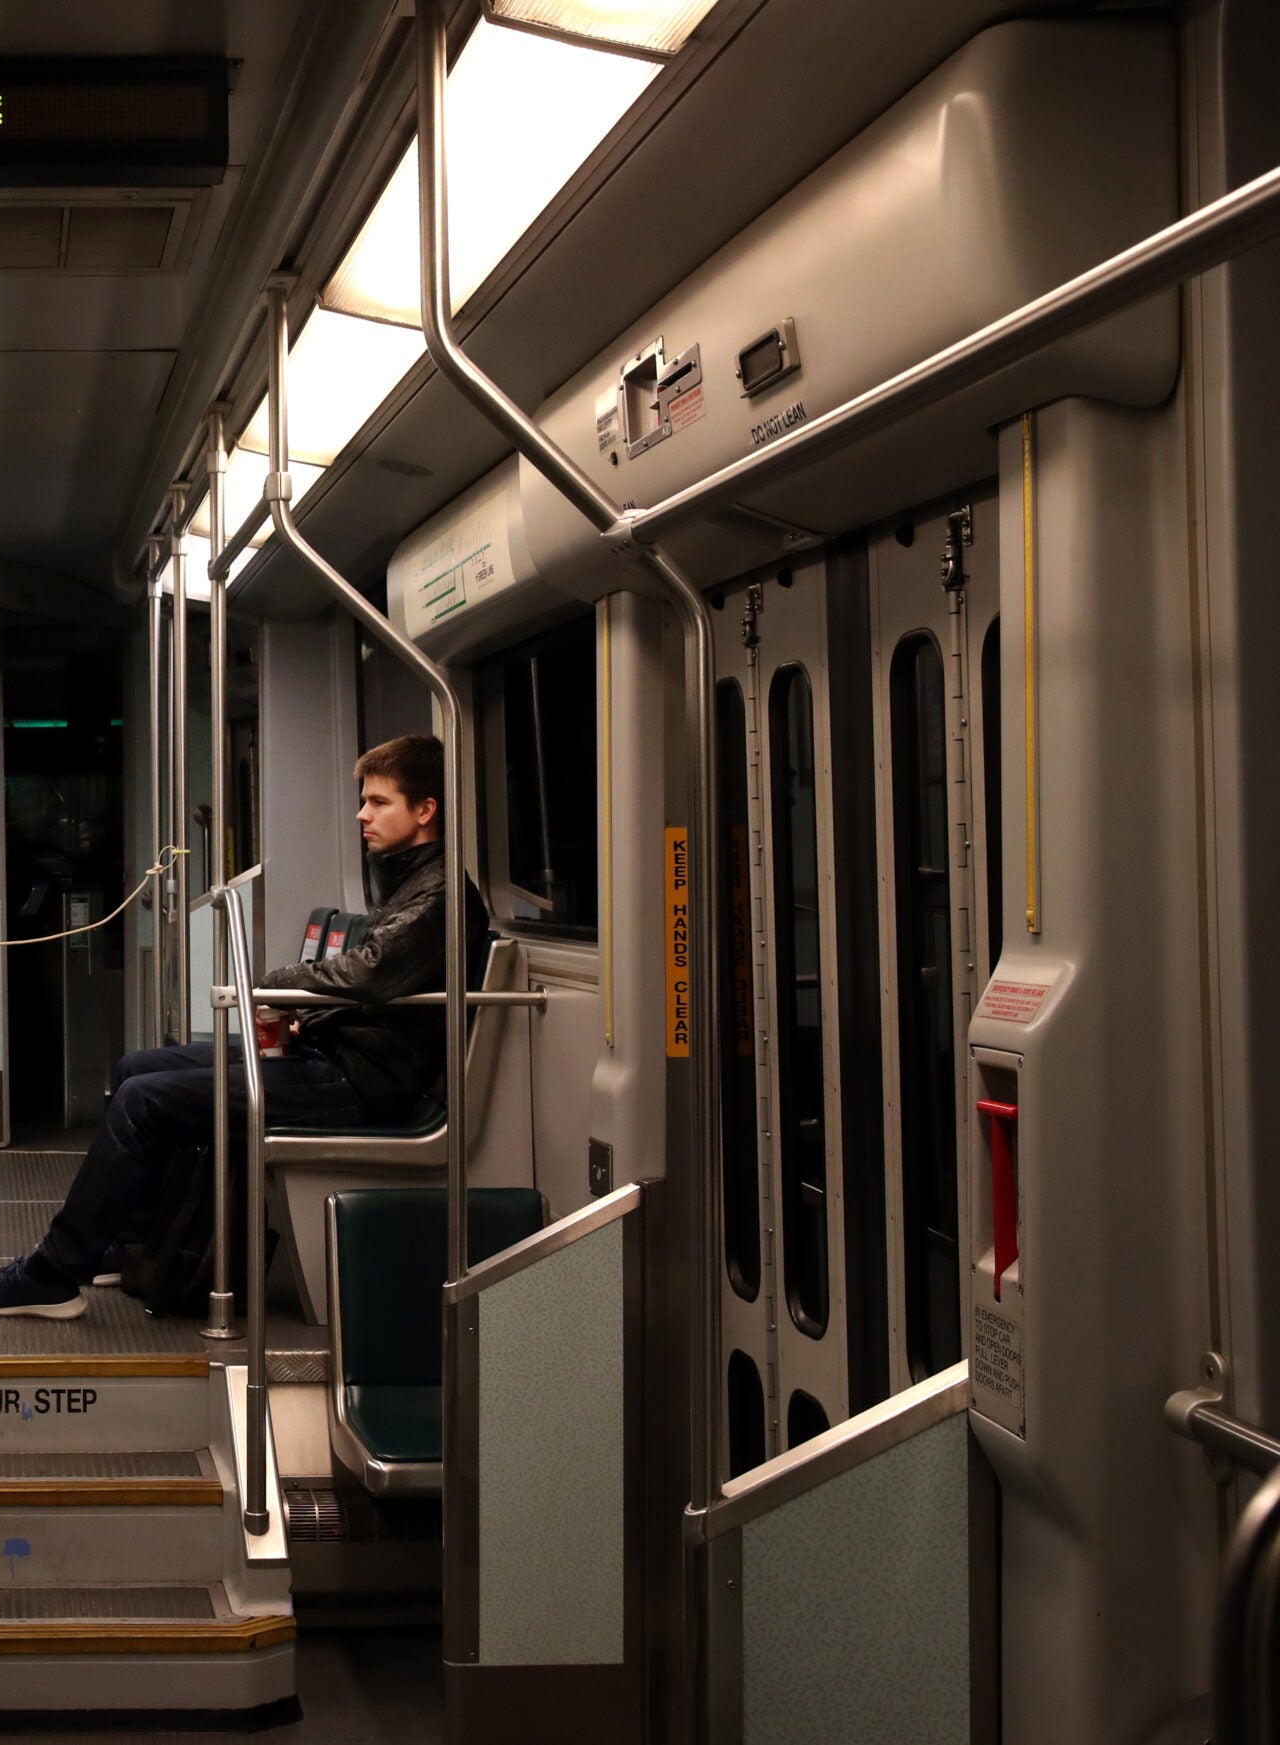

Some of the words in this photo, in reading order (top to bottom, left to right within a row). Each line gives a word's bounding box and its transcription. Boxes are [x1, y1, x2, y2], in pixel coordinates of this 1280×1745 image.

[751, 425, 766, 445] DO
[763, 415, 783, 438] NOT
[781, 401, 807, 428] LEAN
[673, 840, 686, 890] KEEP
[673, 904, 687, 968] HANDS
[674, 981, 688, 1044] CLEAR
[975, 1319, 982, 1331] TO
[983, 1324, 998, 1339] STOP
[999, 1331, 1011, 1345] CAR
[981, 1309, 1015, 1334] EMERGENCY
[975, 1333, 986, 1346] AND
[986, 1338, 1001, 1355] OPEN
[1001, 1346, 1021, 1366] DOORS
[975, 1345, 988, 1360] PULL
[990, 1353, 1008, 1371] LEVER
[975, 1358, 992, 1376] DOWN
[992, 1366, 1005, 1380] AND
[1005, 1374, 1020, 1392] PUSH
[975, 1371, 995, 1390] DOORS
[995, 1382, 1013, 1400] APART
[34, 1388, 98, 1414] STEP
